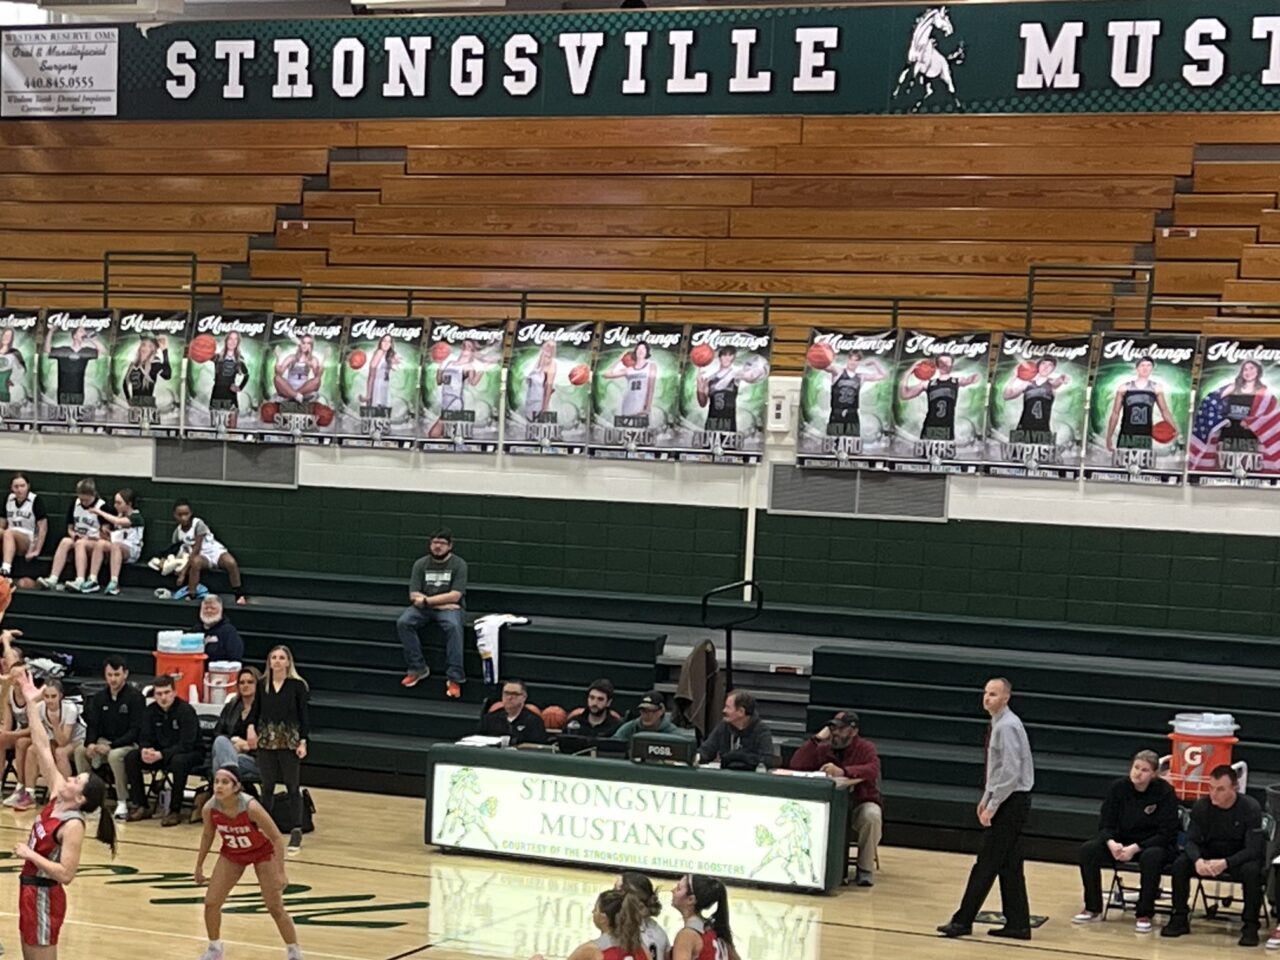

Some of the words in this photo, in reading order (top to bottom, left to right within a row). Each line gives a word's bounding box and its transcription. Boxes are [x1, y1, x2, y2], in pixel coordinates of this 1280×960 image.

[165, 26, 839, 99] STRONGSVILLE
[47, 312, 111, 331] Mustangs
[120, 313, 186, 333] Mustangs
[198, 315, 265, 335] Mustangs
[273, 317, 340, 337] Mustangs
[351, 319, 422, 340] Mustangs
[431, 324, 505, 342] Mustangs
[518, 323, 593, 345] Mustangs
[604, 326, 681, 349] Mustangs
[691, 328, 770, 350] Mustangs
[813, 333, 896, 354] Mustangs
[905, 335, 988, 357] Mustangs
[1003, 338, 1089, 361] Mustangs
[1103, 339, 1193, 363] Mustangs
[1031, 400, 1043, 420] 4
[1130, 406, 1148, 425] 21
[648, 744, 673, 757] POSS.
[1184, 746, 1202, 765] G
[520, 776, 732, 821] STRONGSVILLE
[224, 834, 252, 849] 30
[538, 813, 706, 852] MUSTANGS
[502, 840, 547, 856] COURTESY
[549, 847, 562, 857] OF
[563, 847, 581, 860] THE
[583, 849, 648, 866] STRONGSVILLE
[651, 857, 695, 870] ATHLETIC
[697, 860, 746, 876] BOOSTERS
